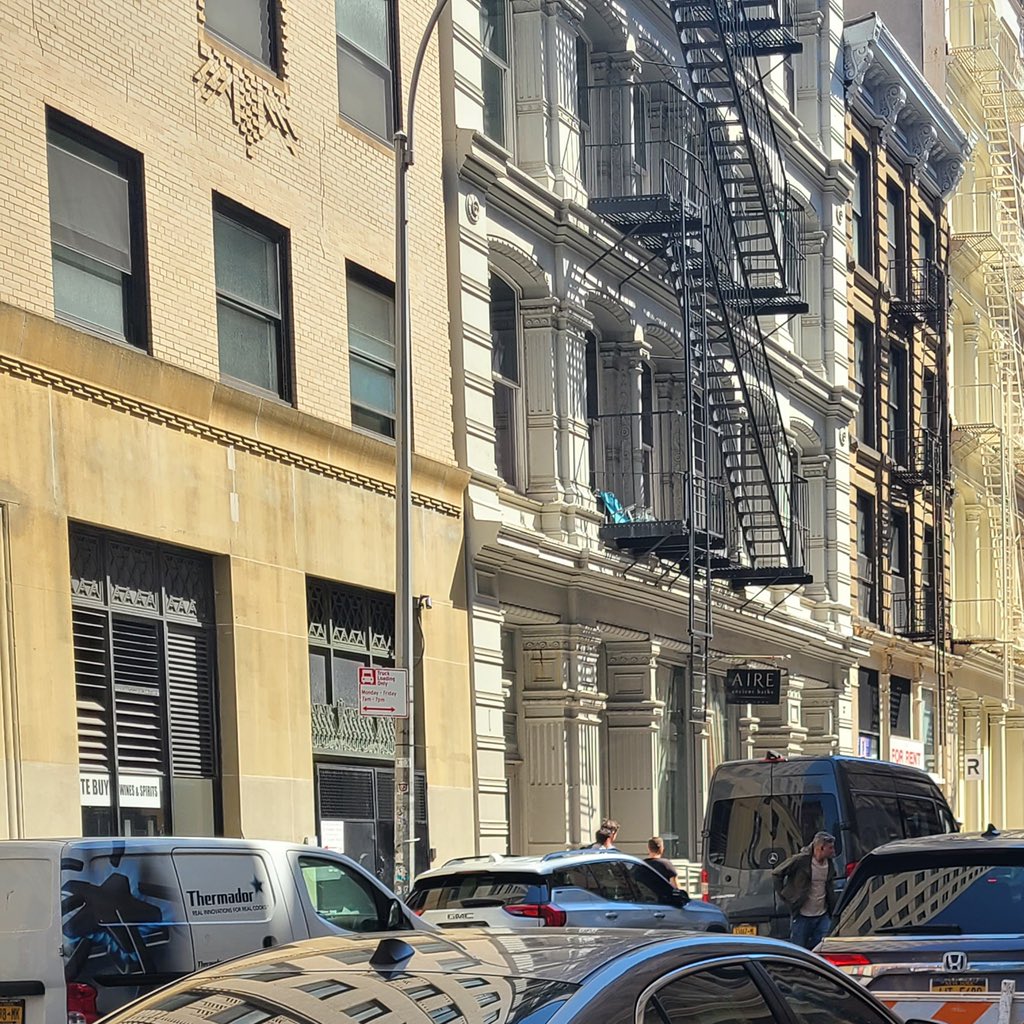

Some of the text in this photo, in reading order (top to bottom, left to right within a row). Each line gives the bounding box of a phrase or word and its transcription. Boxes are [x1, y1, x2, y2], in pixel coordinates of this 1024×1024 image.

[731, 672, 775, 688] AIRE
[892, 748, 921, 766] FOR RENT
[967, 758, 980, 776] R
[92, 779, 110, 797] BUY
[139, 785, 158, 798] SPIRITS
[186, 887, 254, 907] Thermador
[447, 912, 475, 920] GMC
